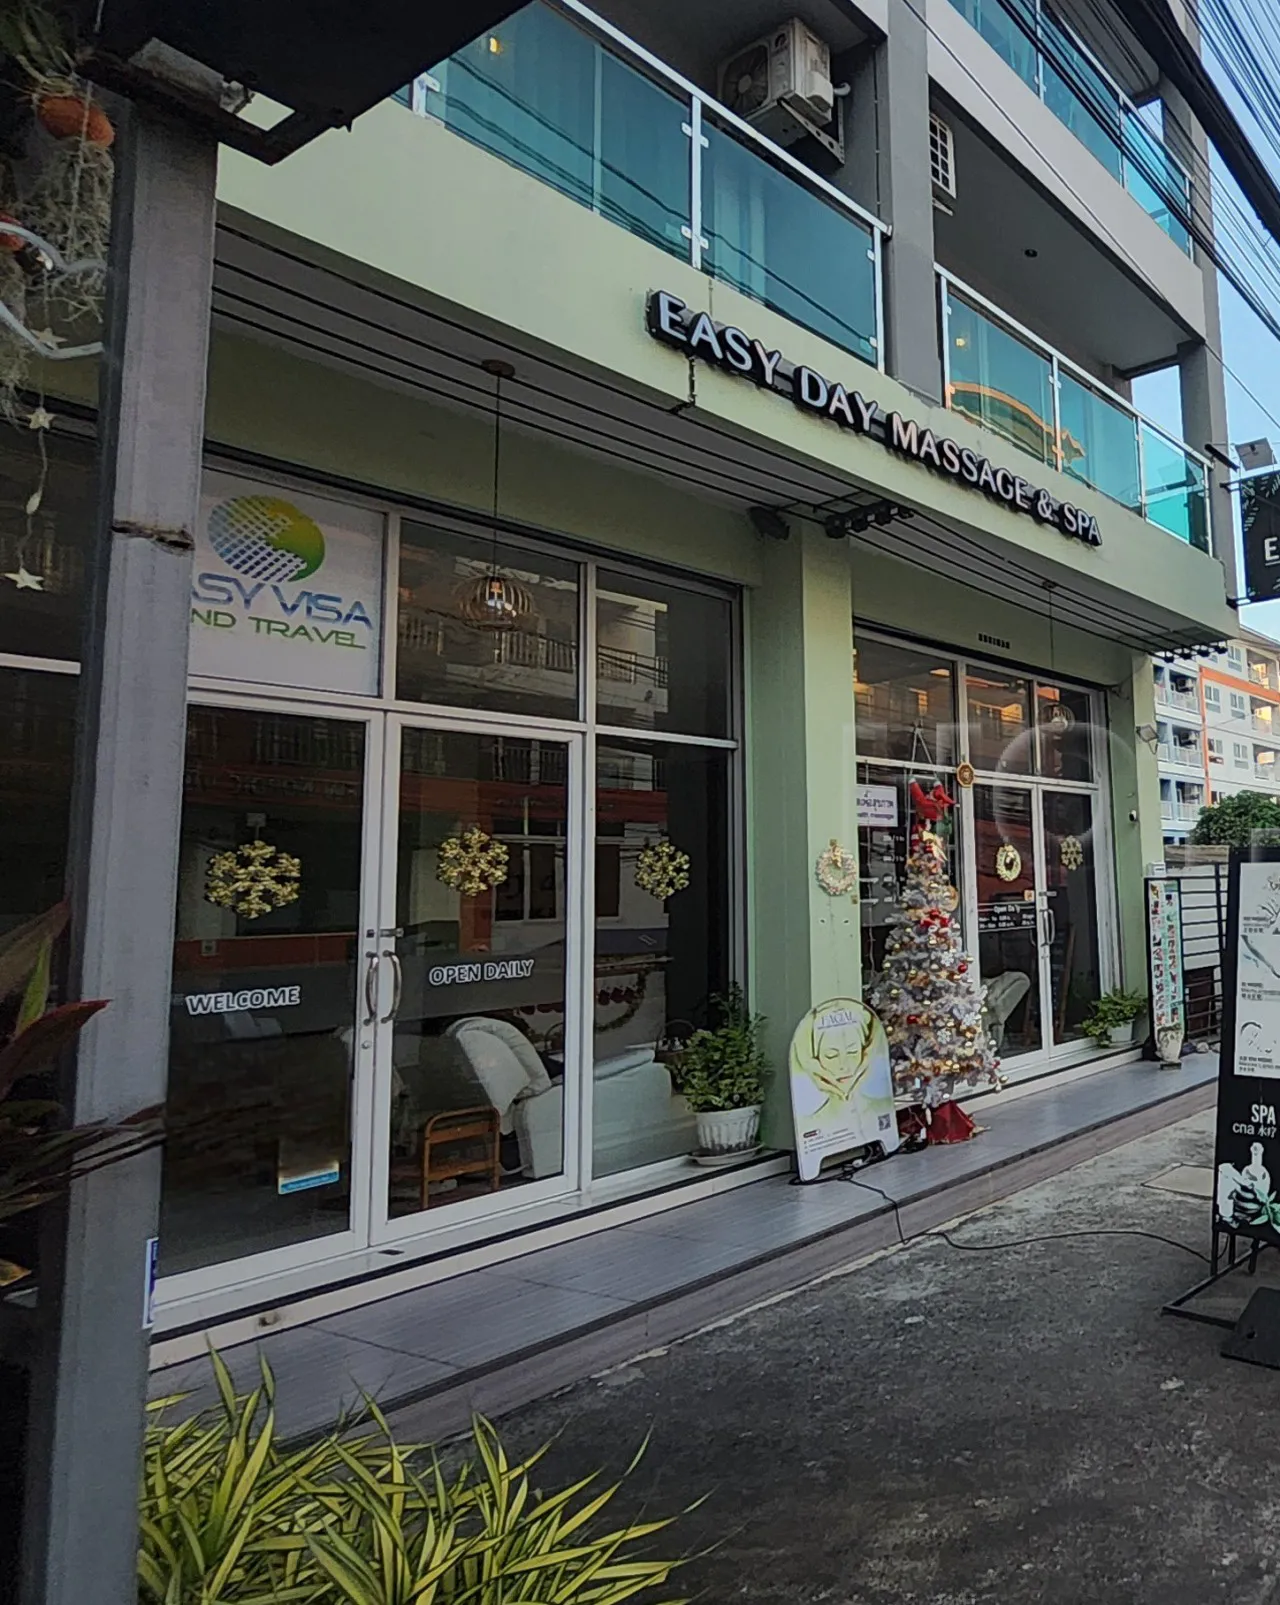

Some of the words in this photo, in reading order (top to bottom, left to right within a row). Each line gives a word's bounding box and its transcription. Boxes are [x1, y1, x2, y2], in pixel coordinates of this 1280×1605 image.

[655, 290, 782, 386] EASY
[798, 364, 879, 433] DAY
[890, 411, 1031, 510] MASSAGE
[1036, 487, 1055, 521] &
[1063, 502, 1103, 546] SPA
[192, 572, 266, 610] SY
[270, 584, 374, 631] VISA
[190, 607, 237, 629] ND
[247, 615, 367, 650] TRAVEL
[428, 963, 482, 986] OPEN
[483, 959, 535, 982] DAILY
[185, 985, 301, 1015] WELCOME
[1251, 1103, 1276, 1125] SPA
